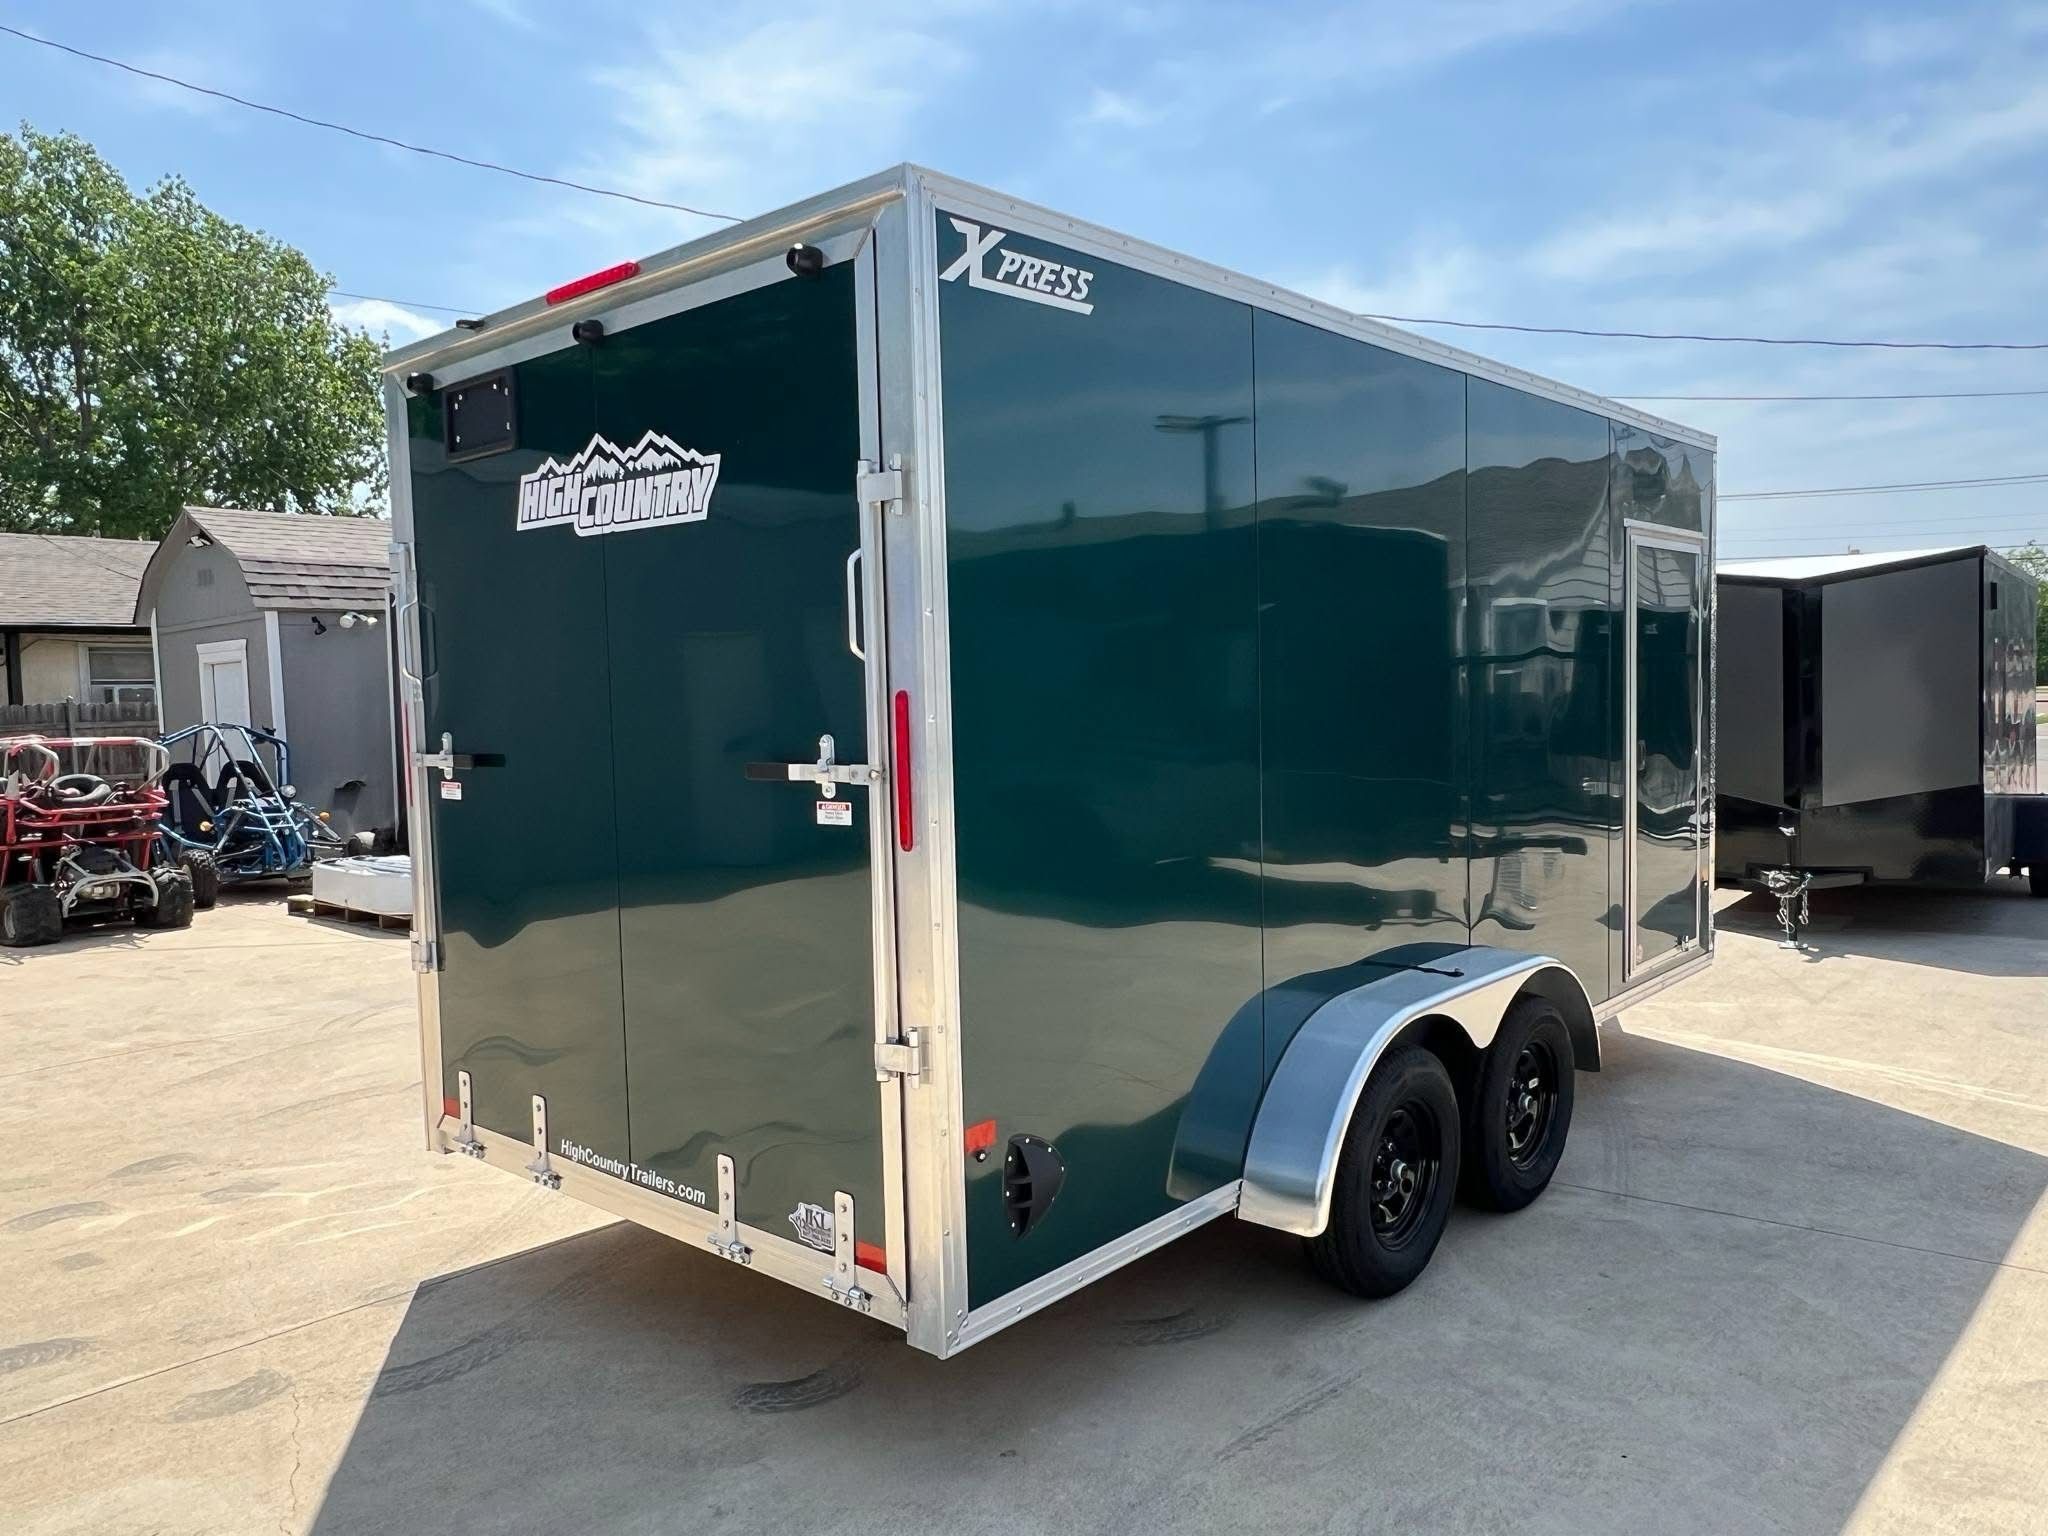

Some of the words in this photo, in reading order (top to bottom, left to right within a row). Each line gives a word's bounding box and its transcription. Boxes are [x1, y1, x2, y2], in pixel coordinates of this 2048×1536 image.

[939, 217, 1094, 306] XPRESS
[521, 472, 584, 523] HIGH
[578, 464, 715, 528] COUNTRY
[560, 1138, 706, 1205] HighCountryTrailers.com
